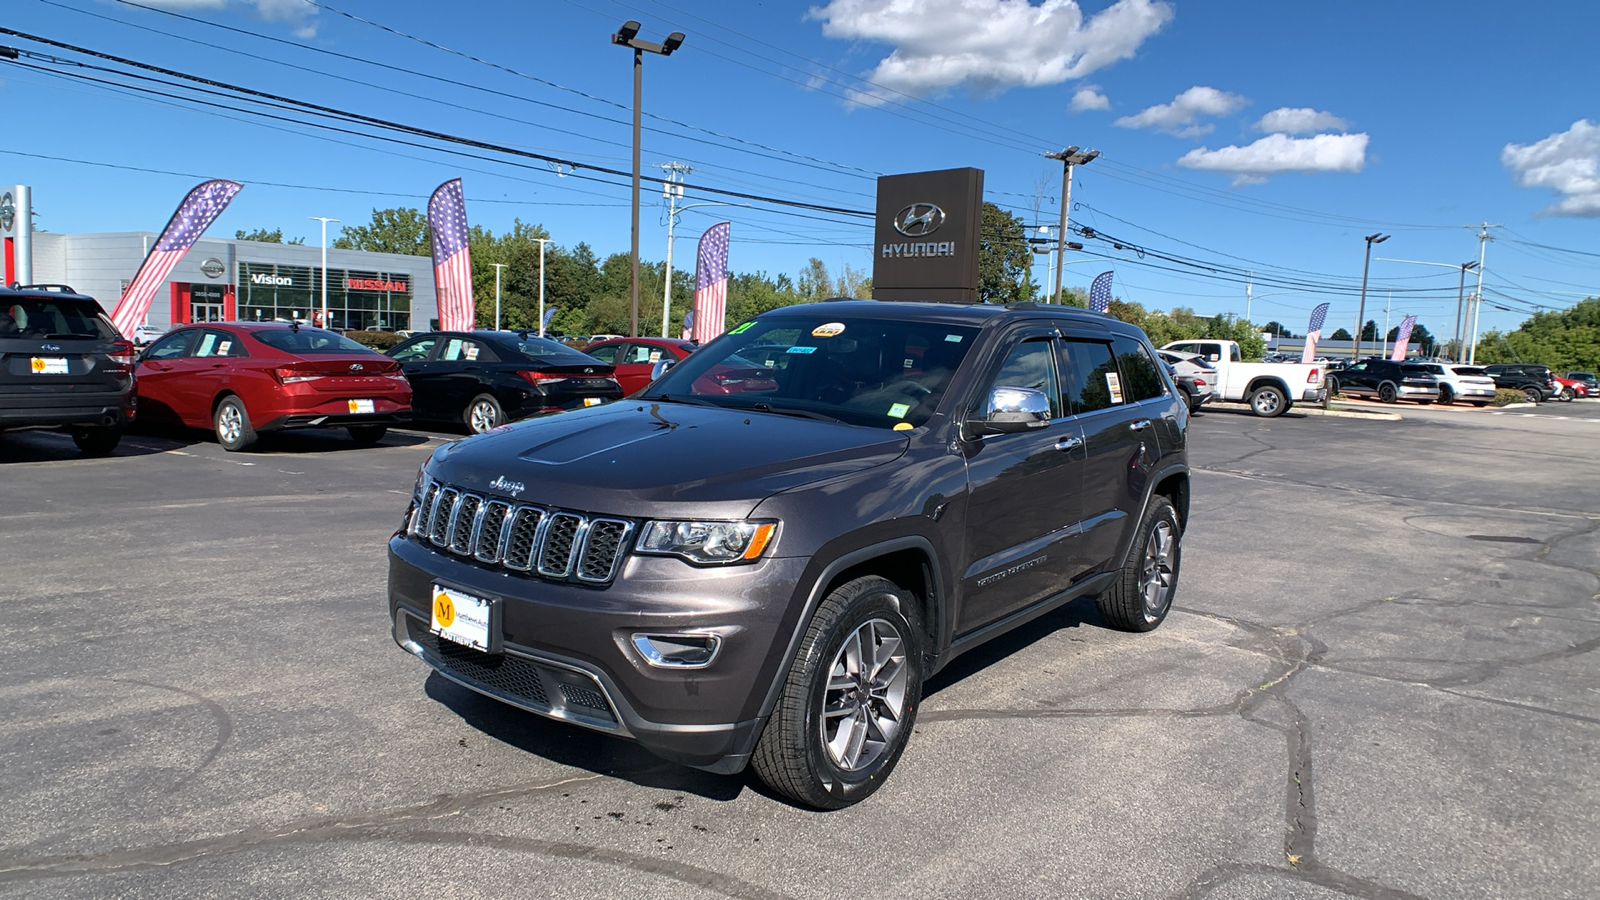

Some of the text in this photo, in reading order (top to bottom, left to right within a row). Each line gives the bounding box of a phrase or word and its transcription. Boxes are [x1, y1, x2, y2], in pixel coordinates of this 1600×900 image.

[882, 241, 955, 258] HYUNDAI
[251, 273, 407, 292] Vision NISSAN
[488, 475, 525, 497] Jeep
[437, 600, 451, 621] M
